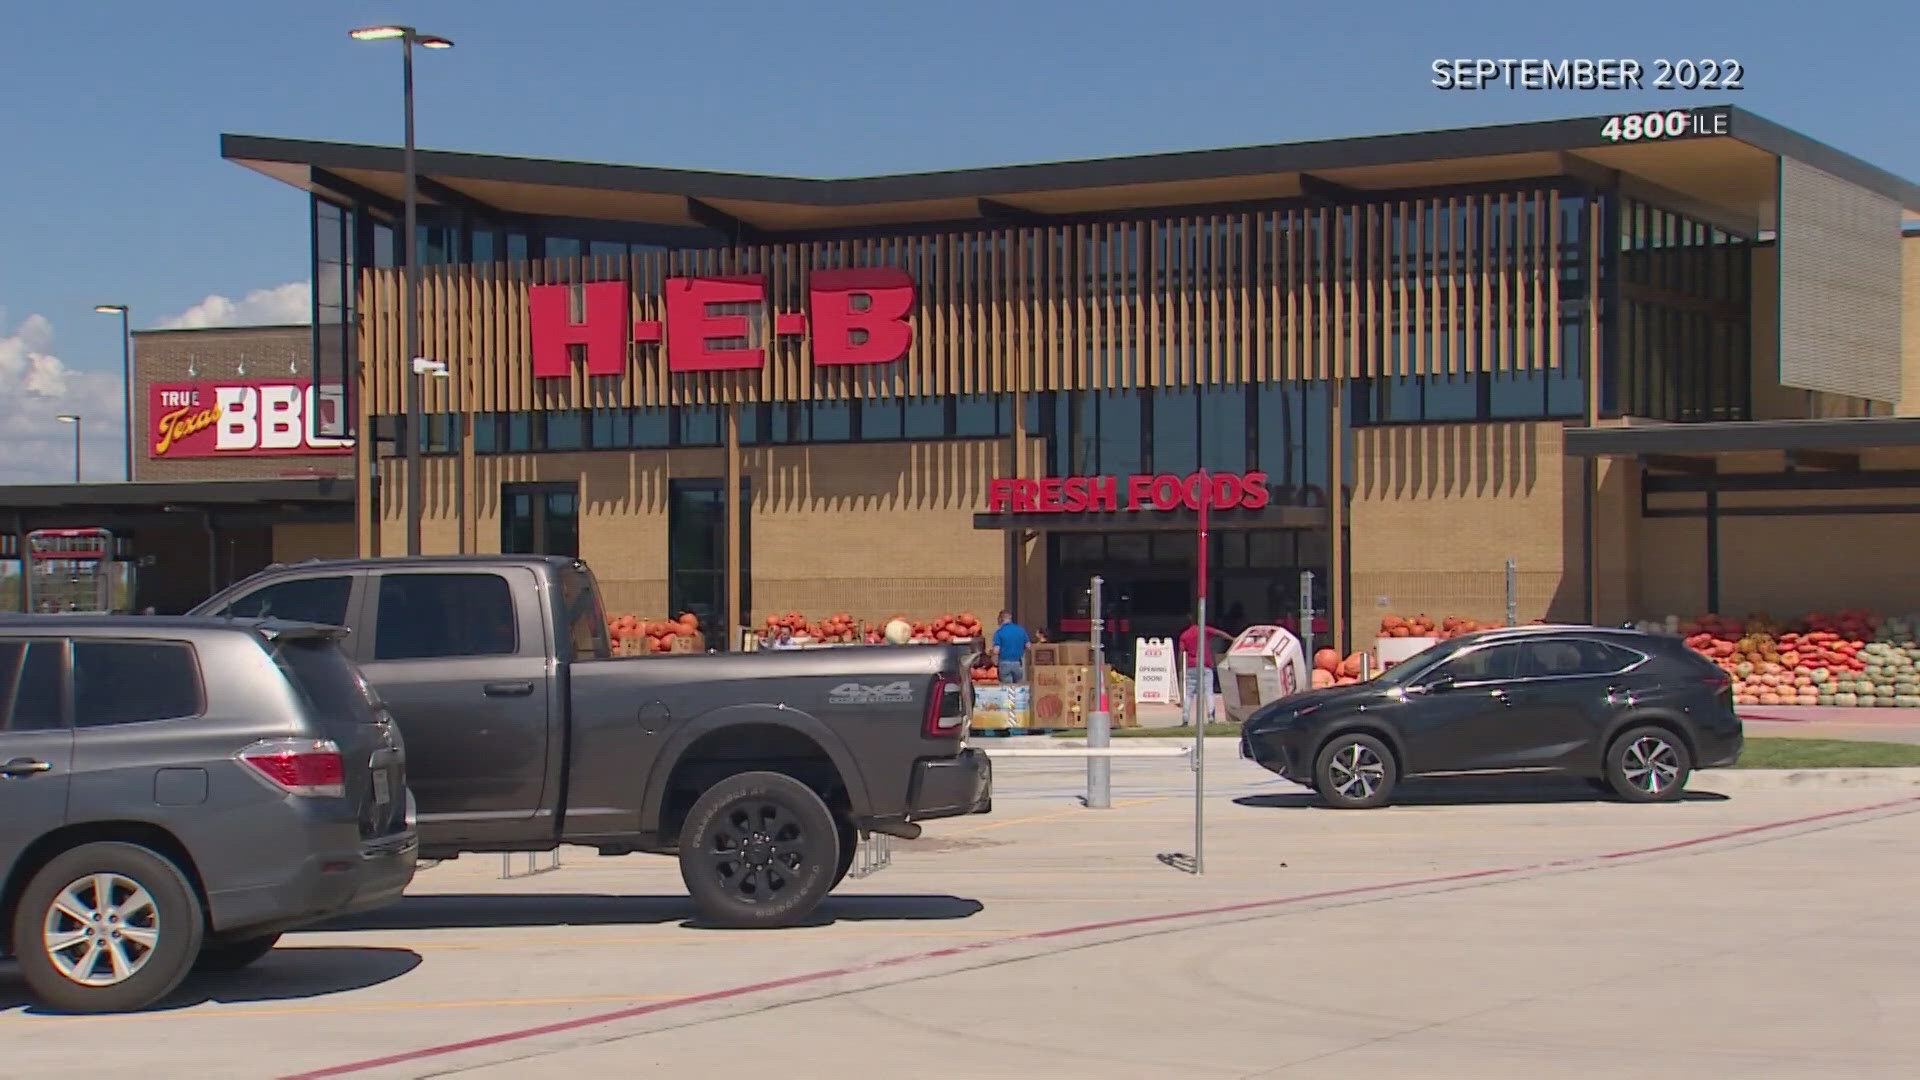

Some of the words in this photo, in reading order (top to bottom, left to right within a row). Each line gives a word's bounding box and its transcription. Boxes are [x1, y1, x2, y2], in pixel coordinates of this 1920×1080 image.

[1602, 111, 1686, 141] 4800
[528, 267, 915, 378] H-E-B
[161, 391, 200, 406] TRUE
[155, 401, 224, 454] Texas
[988, 475, 1117, 513] FRESH
[1128, 472, 1270, 512] FOODS
